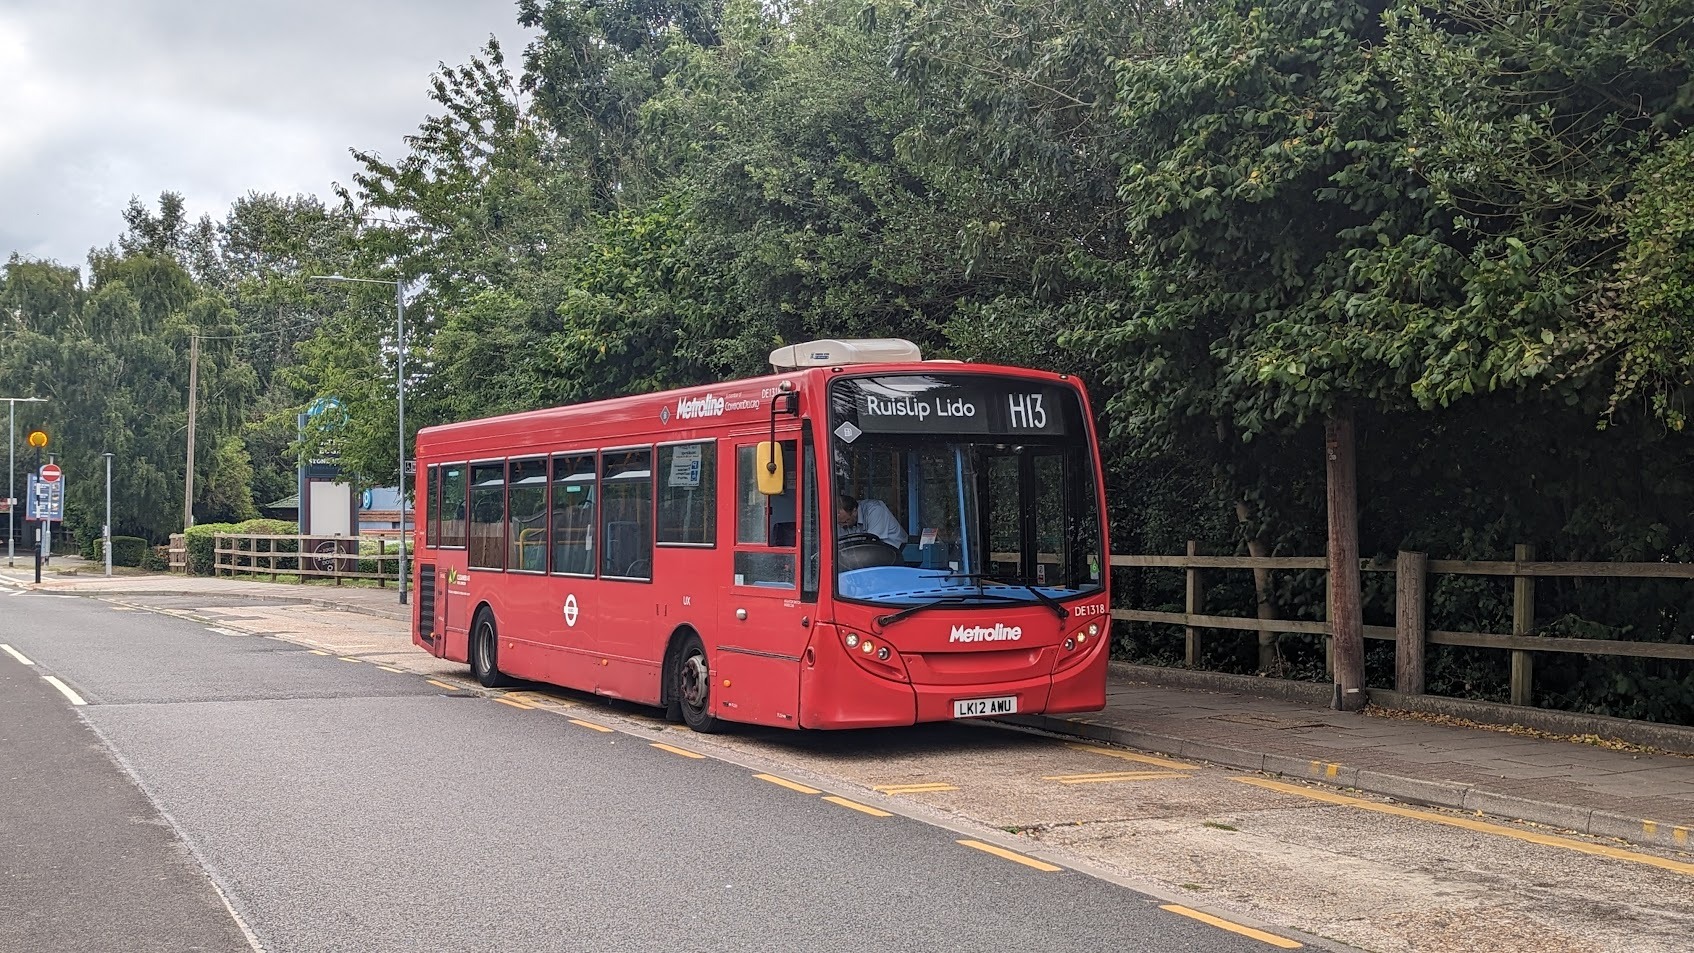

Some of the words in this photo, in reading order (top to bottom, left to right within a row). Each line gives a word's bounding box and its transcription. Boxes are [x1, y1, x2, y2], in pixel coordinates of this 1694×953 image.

[676, 393, 725, 420] Metroline
[867, 396, 931, 421] Ruislip
[936, 398, 976, 417] Lido
[1008, 393, 1047, 428] H13
[1074, 604, 1106, 617] DE1318
[949, 623, 1022, 643] Metroline
[960, 701, 986, 716] LK12
[990, 699, 1012, 713] AWU
